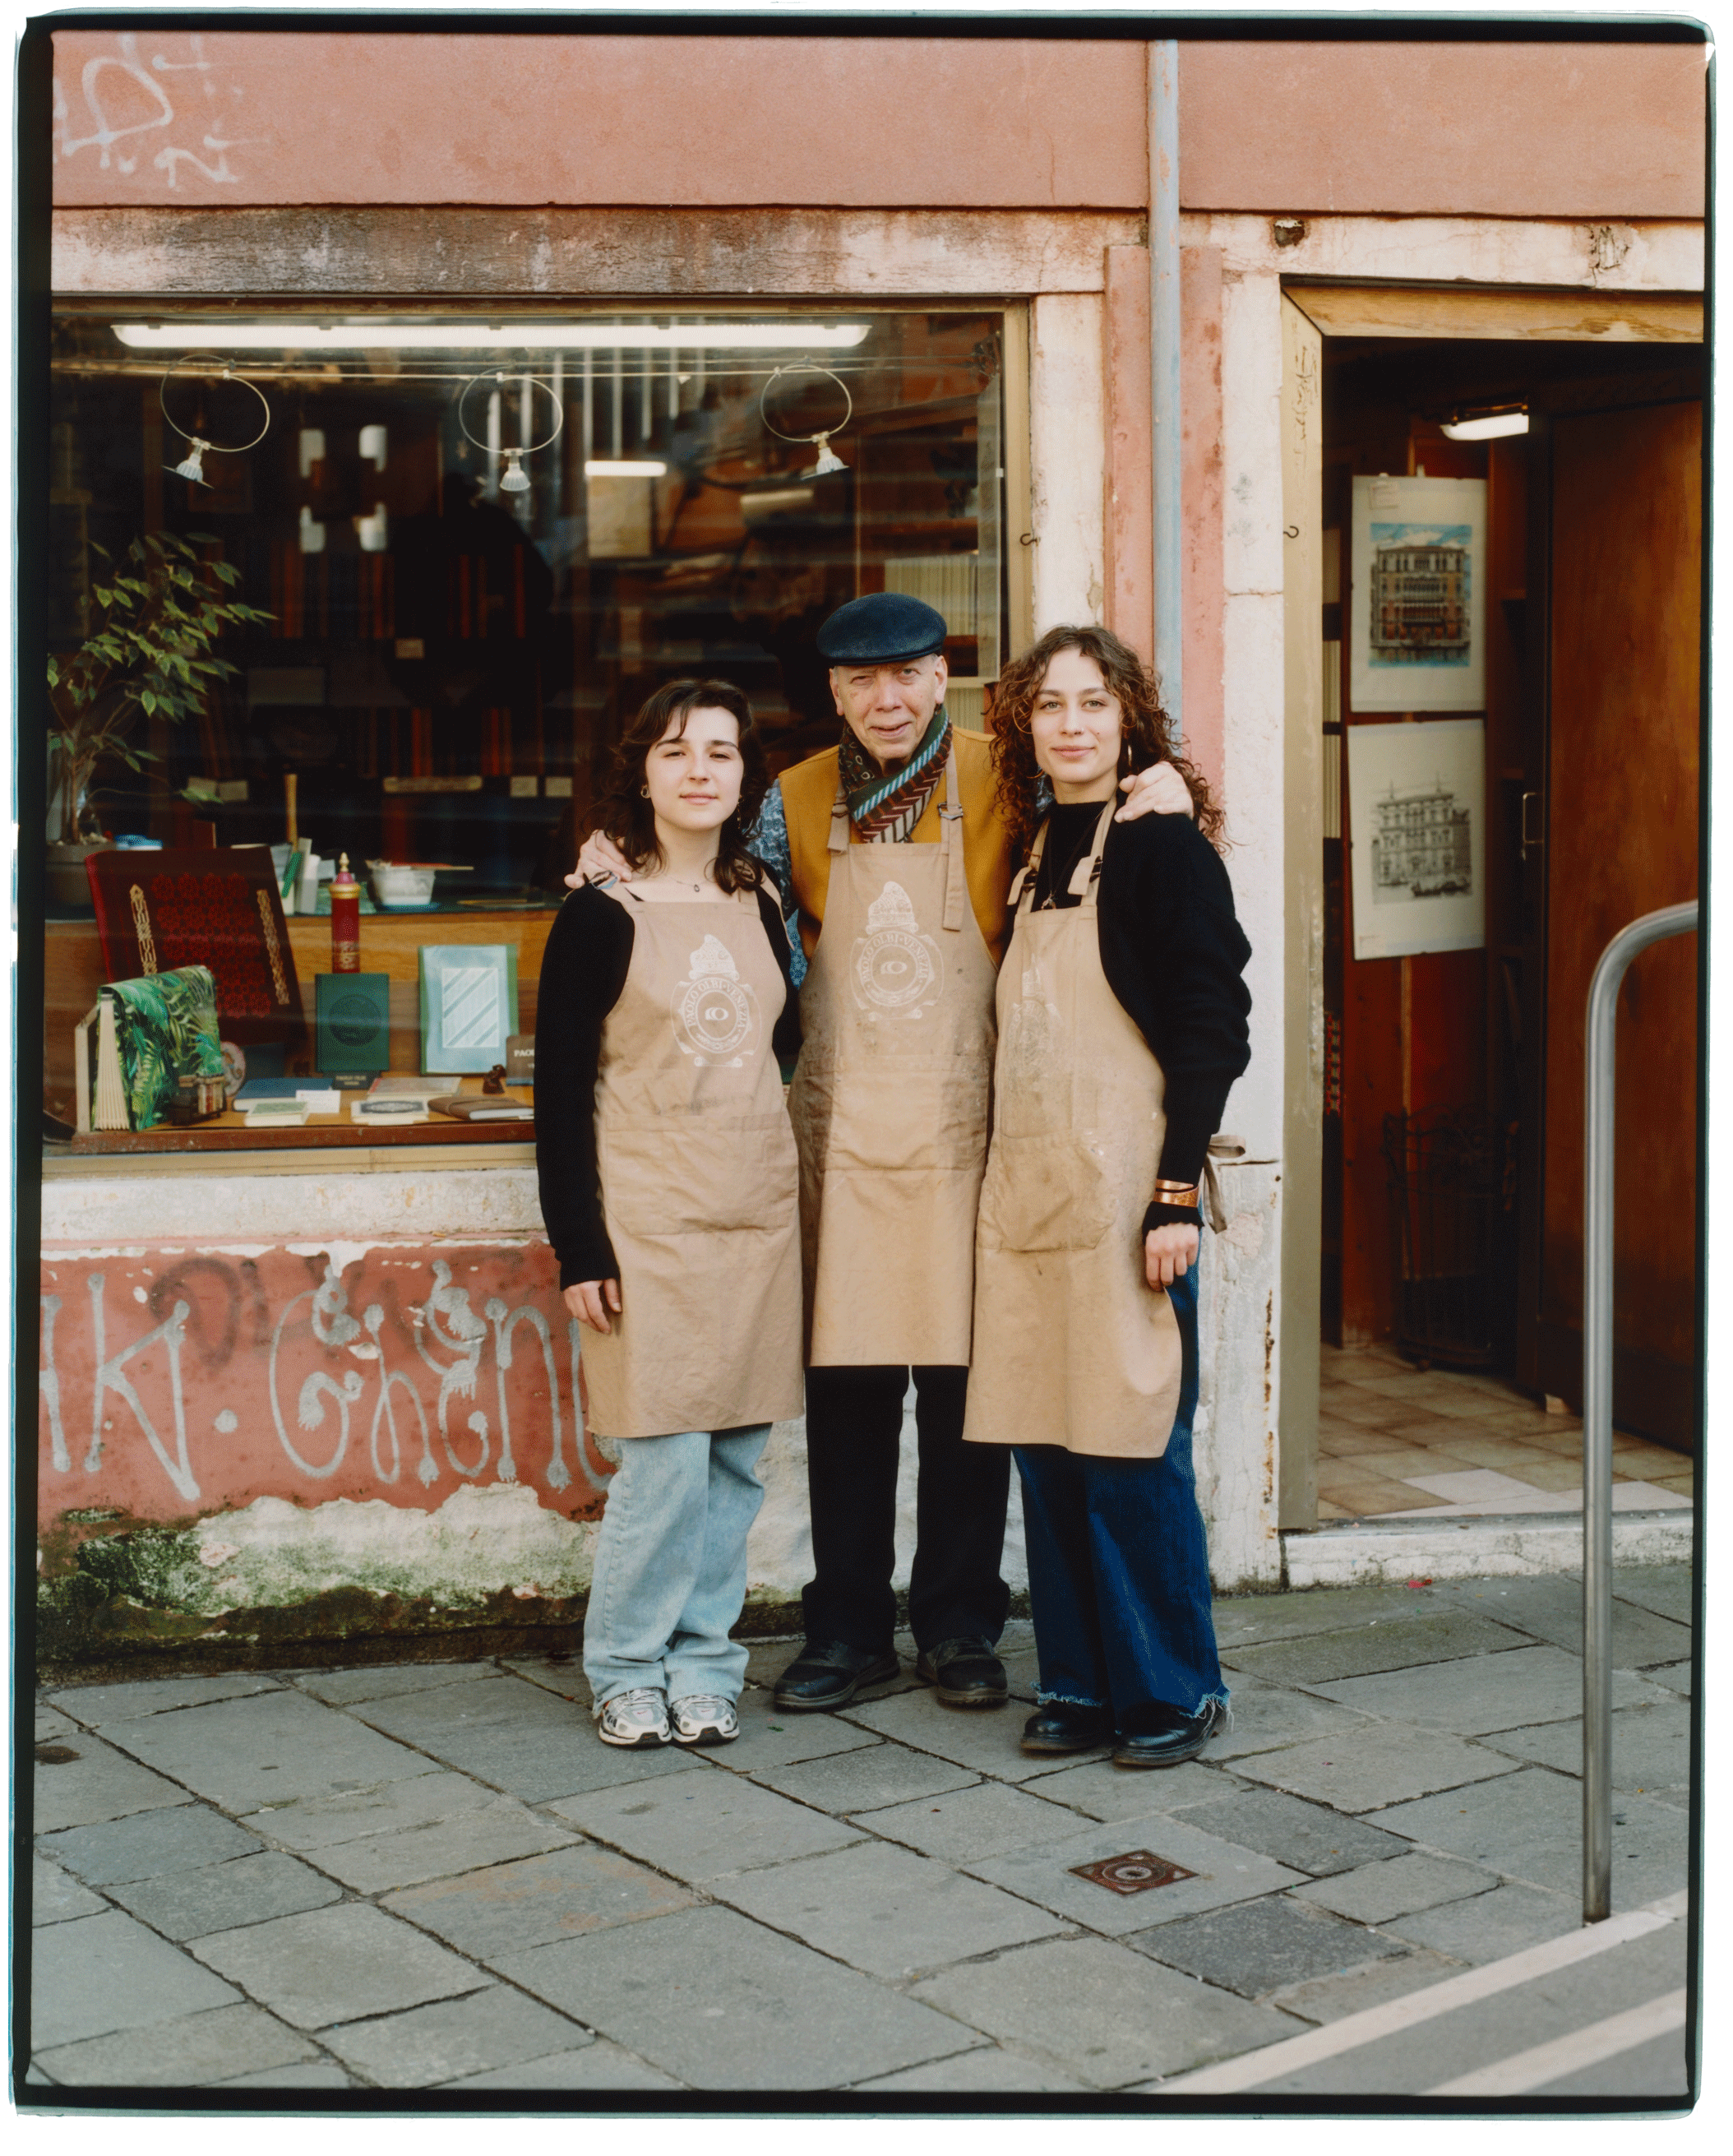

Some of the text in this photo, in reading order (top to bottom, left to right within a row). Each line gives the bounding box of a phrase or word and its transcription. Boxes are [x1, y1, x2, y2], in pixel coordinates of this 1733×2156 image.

[862, 933, 929, 983] PAOLO OLBI VENEZIA
[686, 979, 747, 1028] PAOLO OLBI VENEZIA
